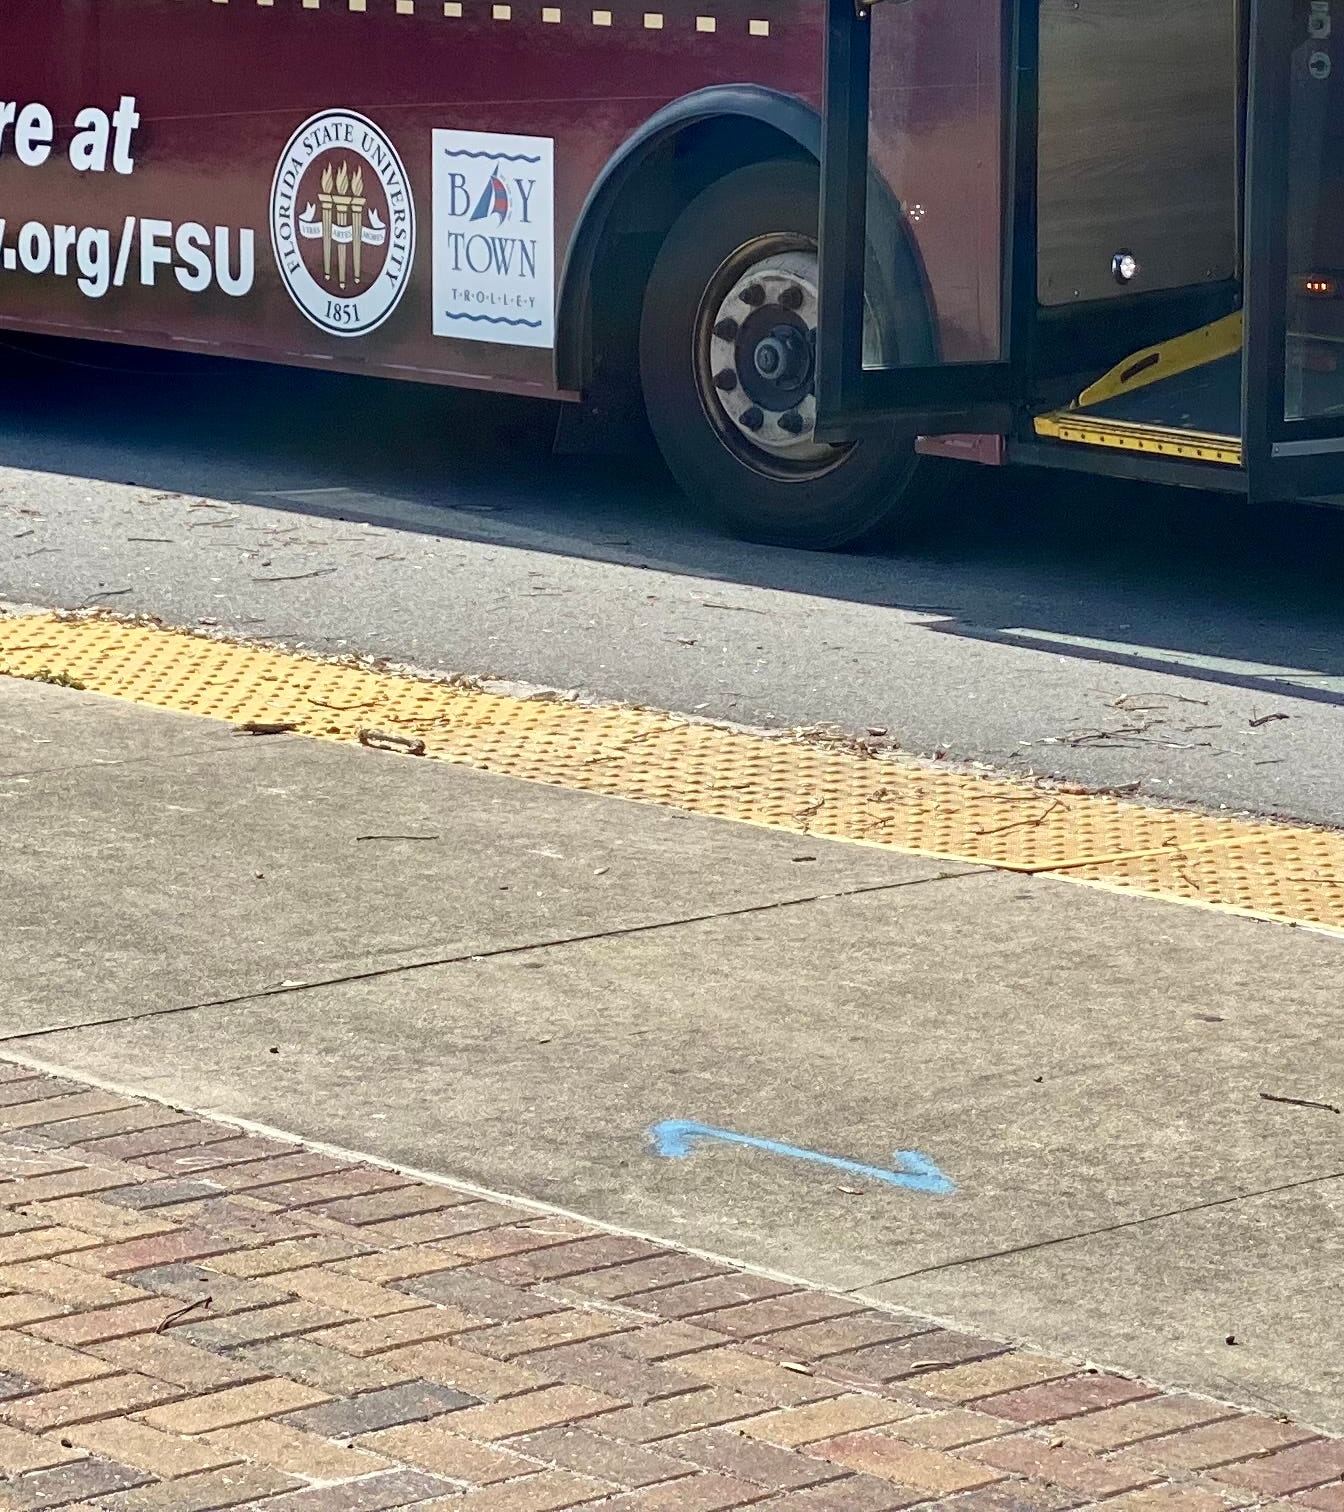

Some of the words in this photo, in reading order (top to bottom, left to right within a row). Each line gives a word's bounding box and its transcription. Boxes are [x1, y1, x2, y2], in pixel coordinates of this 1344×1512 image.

[69, 95, 140, 174] at
[278, 156, 303, 275] FLORIDA
[302, 122, 354, 156] STATE
[361, 131, 407, 290] UNIVERSITY
[448, 230, 536, 279] TOWN
[324, 300, 360, 324] 1851
